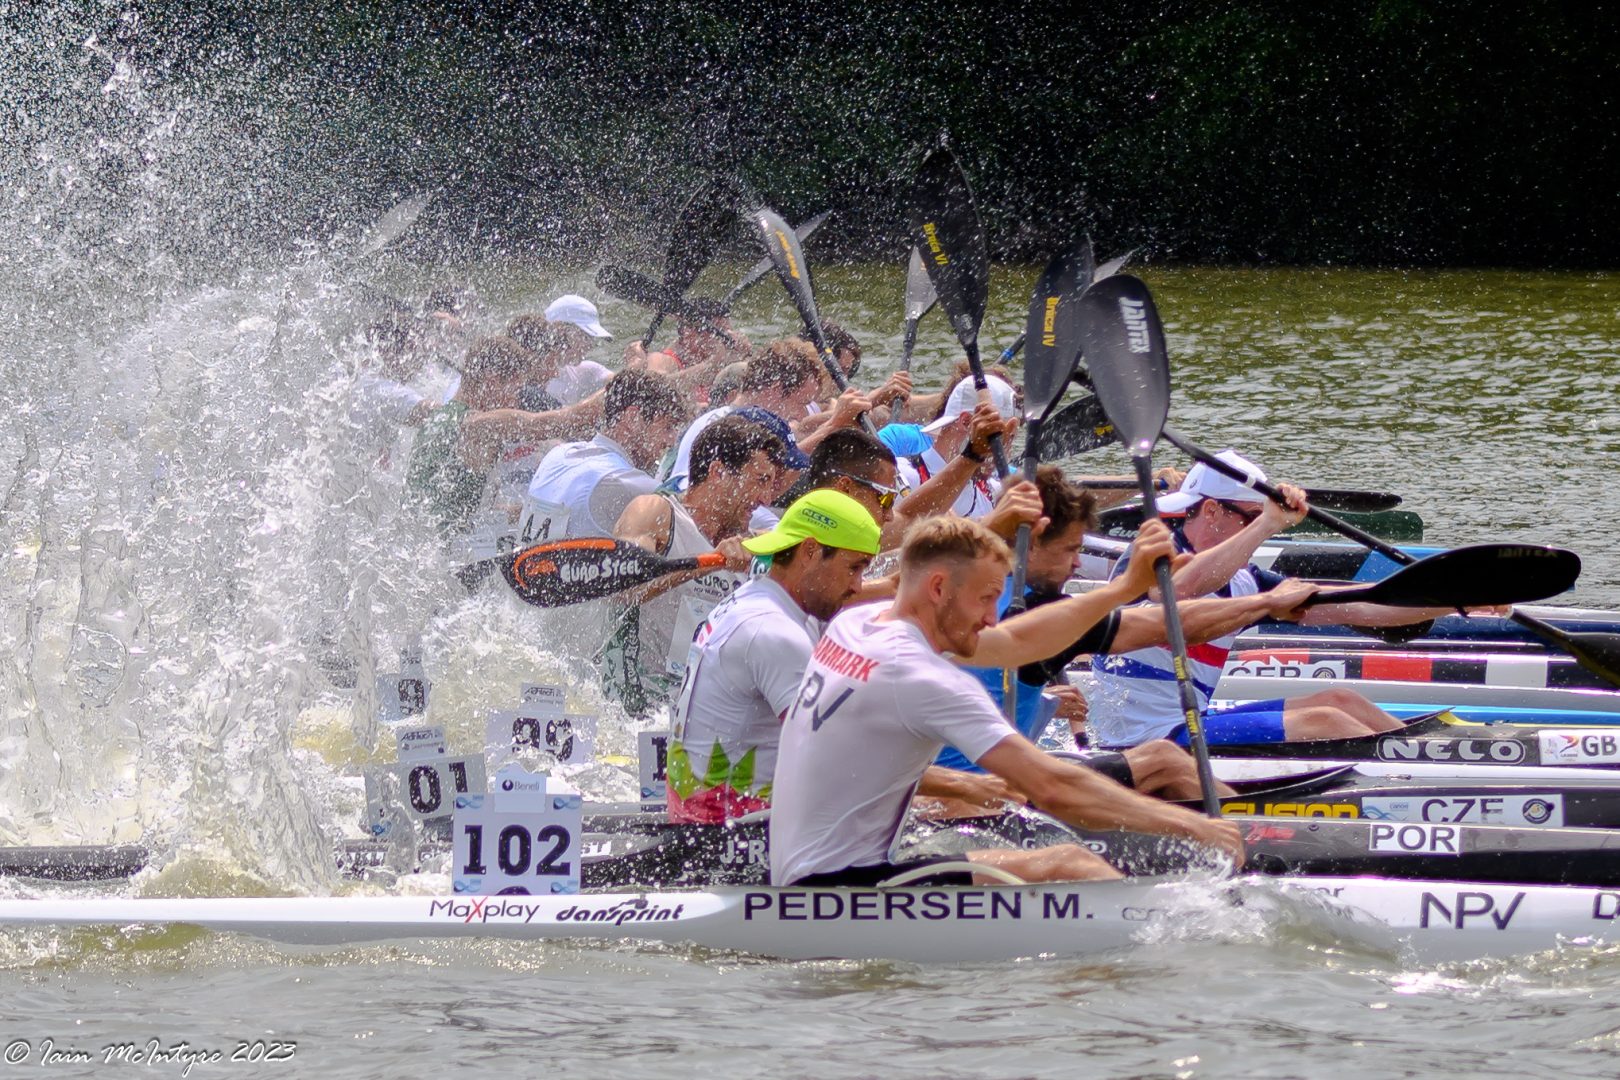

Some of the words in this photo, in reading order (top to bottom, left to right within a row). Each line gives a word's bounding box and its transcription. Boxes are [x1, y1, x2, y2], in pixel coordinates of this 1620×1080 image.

[813, 634, 880, 683] NMARK
[1382, 738, 1521, 762] NELO
[463, 824, 571, 876] 102
[1371, 824, 1457, 853] POR
[744, 891, 1022, 921] PEDERSEN
[1043, 891, 1094, 920] M.
